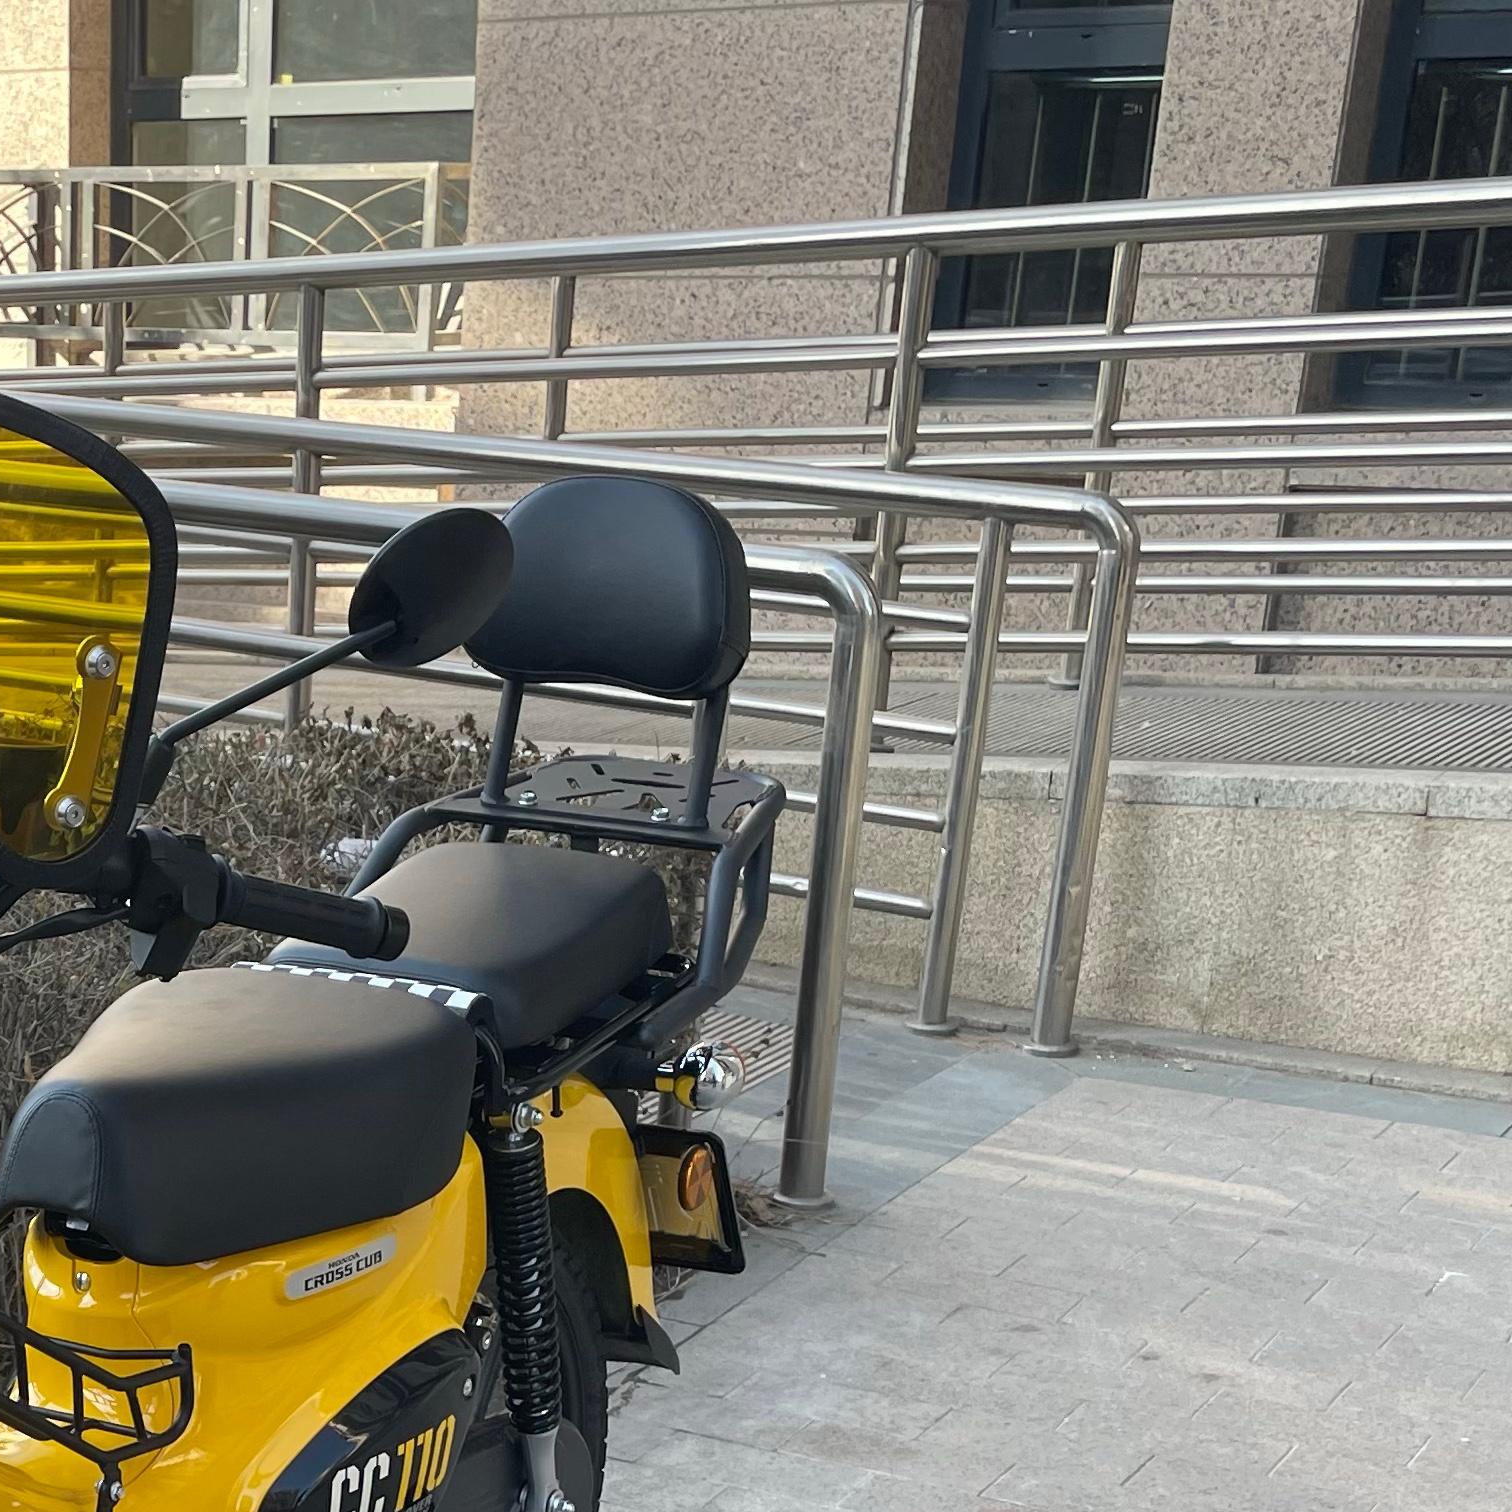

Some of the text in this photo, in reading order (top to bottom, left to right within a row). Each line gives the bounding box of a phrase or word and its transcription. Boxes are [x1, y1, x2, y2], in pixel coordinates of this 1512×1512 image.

[304, 1250, 383, 1291] CROSS CUB
[328, 1252, 361, 1269] HONDA
